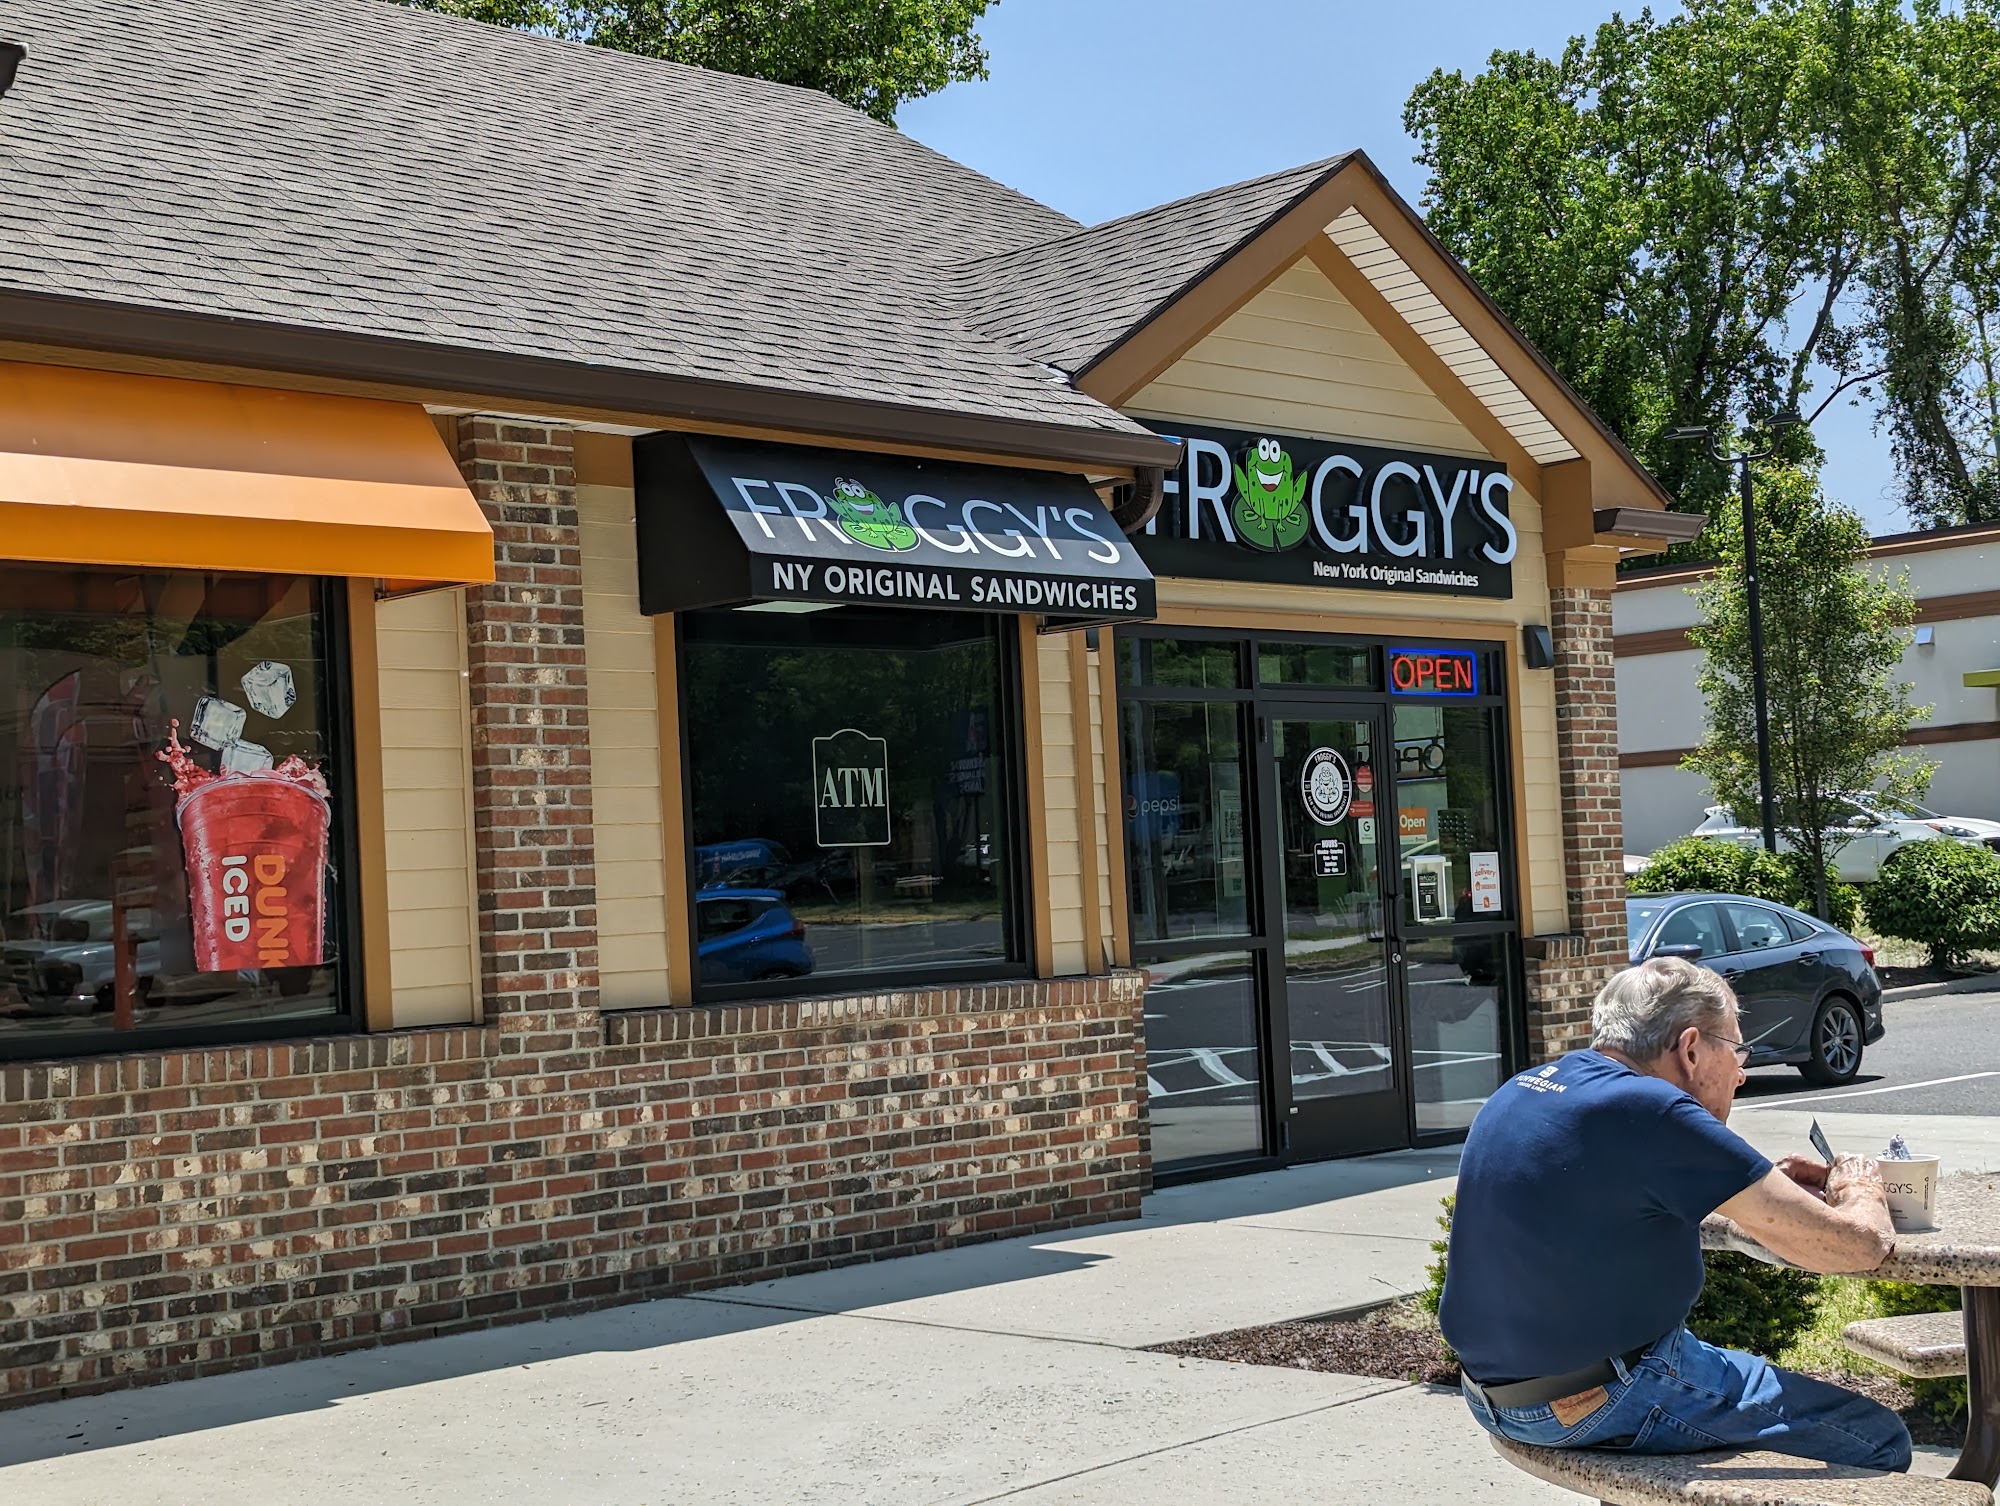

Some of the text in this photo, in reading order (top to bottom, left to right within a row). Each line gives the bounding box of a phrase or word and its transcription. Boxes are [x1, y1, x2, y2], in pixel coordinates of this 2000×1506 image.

[1146, 434, 1518, 564] RGGY'S
[731, 476, 1121, 565] FRGGY'S
[773, 562, 1138, 611] NY ORIGINAL SANDWICHES
[1313, 561, 1479, 587] New York Original Sandwiches
[1393, 655, 1472, 689] OPEN
[819, 767, 886, 808] ATM
[1141, 795, 1180, 817] pepsi
[1399, 814, 1426, 832] Open
[221, 855, 251, 942] ICED
[1515, 1074, 1568, 1093] NORWEGIAN
